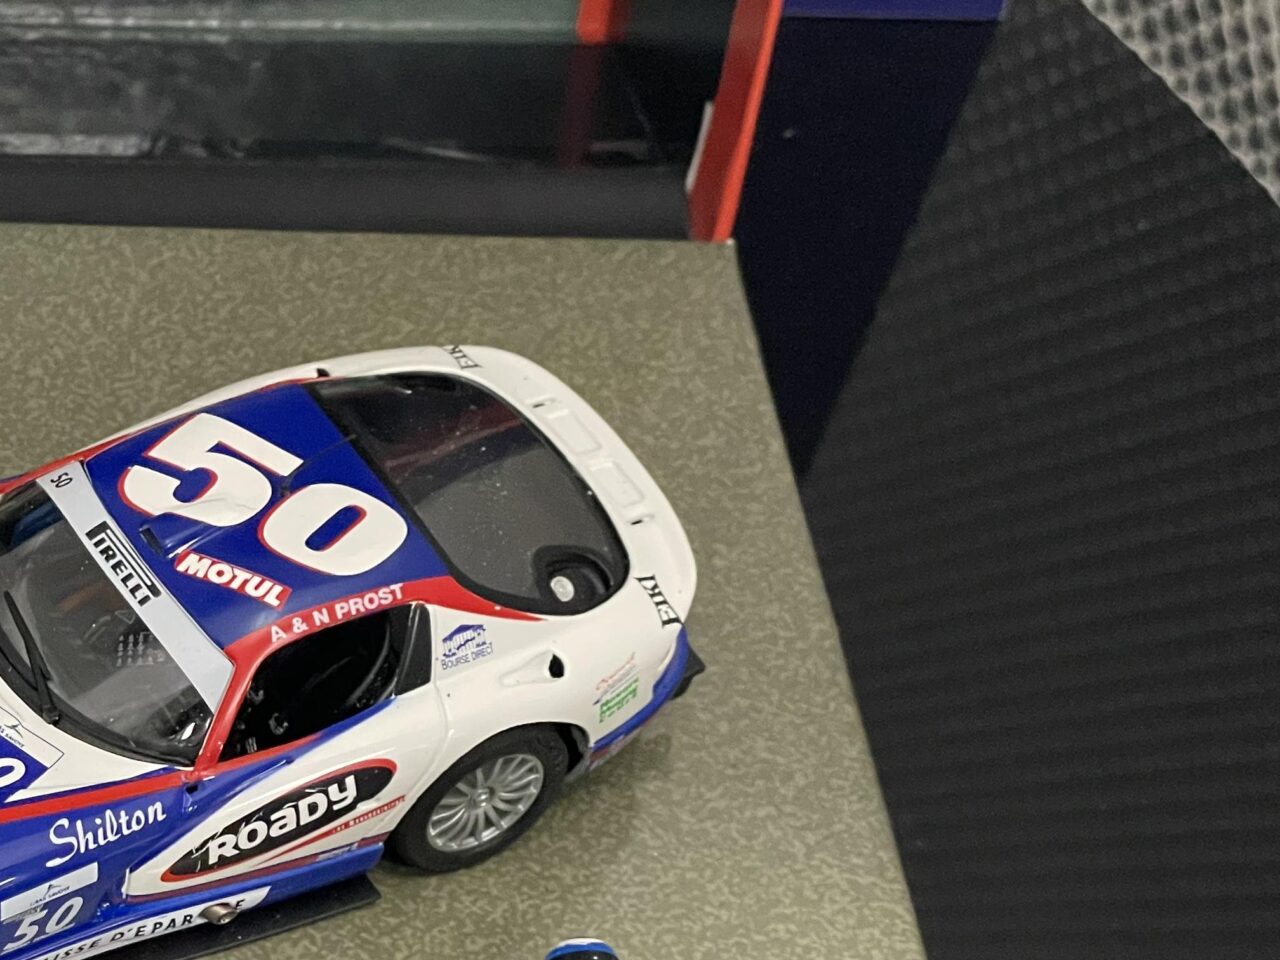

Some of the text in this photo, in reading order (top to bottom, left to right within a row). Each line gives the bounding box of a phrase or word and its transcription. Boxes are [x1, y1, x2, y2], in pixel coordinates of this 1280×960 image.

[50, 472, 73, 488] 50
[119, 412, 409, 576] 50
[85, 520, 161, 607] PIRELLI
[175, 550, 286, 608] MOTUL
[271, 583, 405, 644] A & N PROST
[441, 642, 494, 671] BOURSE DIRECT
[45, 801, 167, 868] Shilton
[3, 896, 84, 951] 50
[110, 897, 246, 944] D'EPARE
